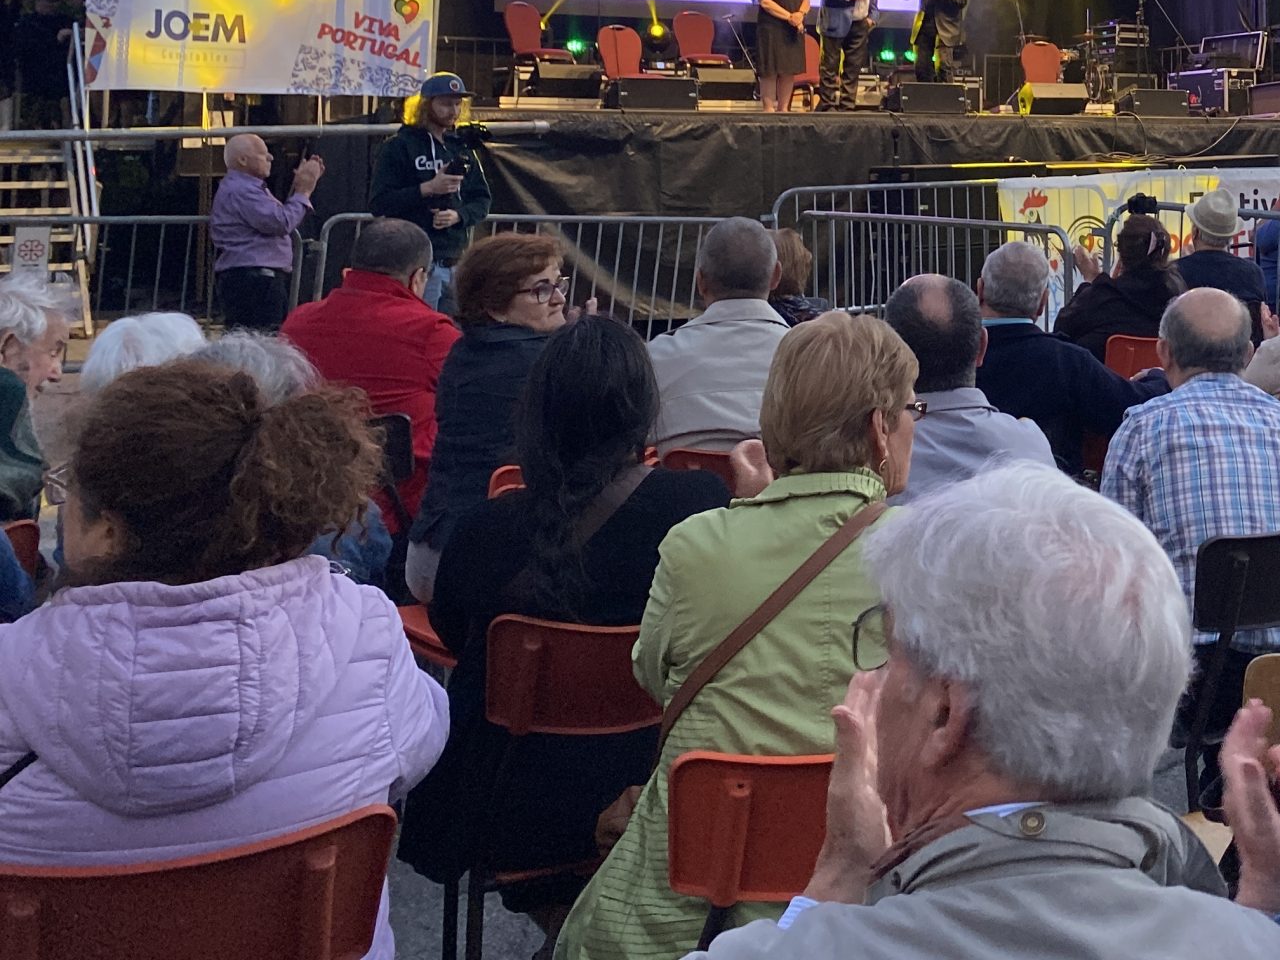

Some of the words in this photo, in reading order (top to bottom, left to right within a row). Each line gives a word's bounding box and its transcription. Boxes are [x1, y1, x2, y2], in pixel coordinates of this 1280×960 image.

[145, 8, 246, 44] JOEM
[354, 11, 401, 42] VIVA
[317, 22, 422, 68] PORTUGAL
